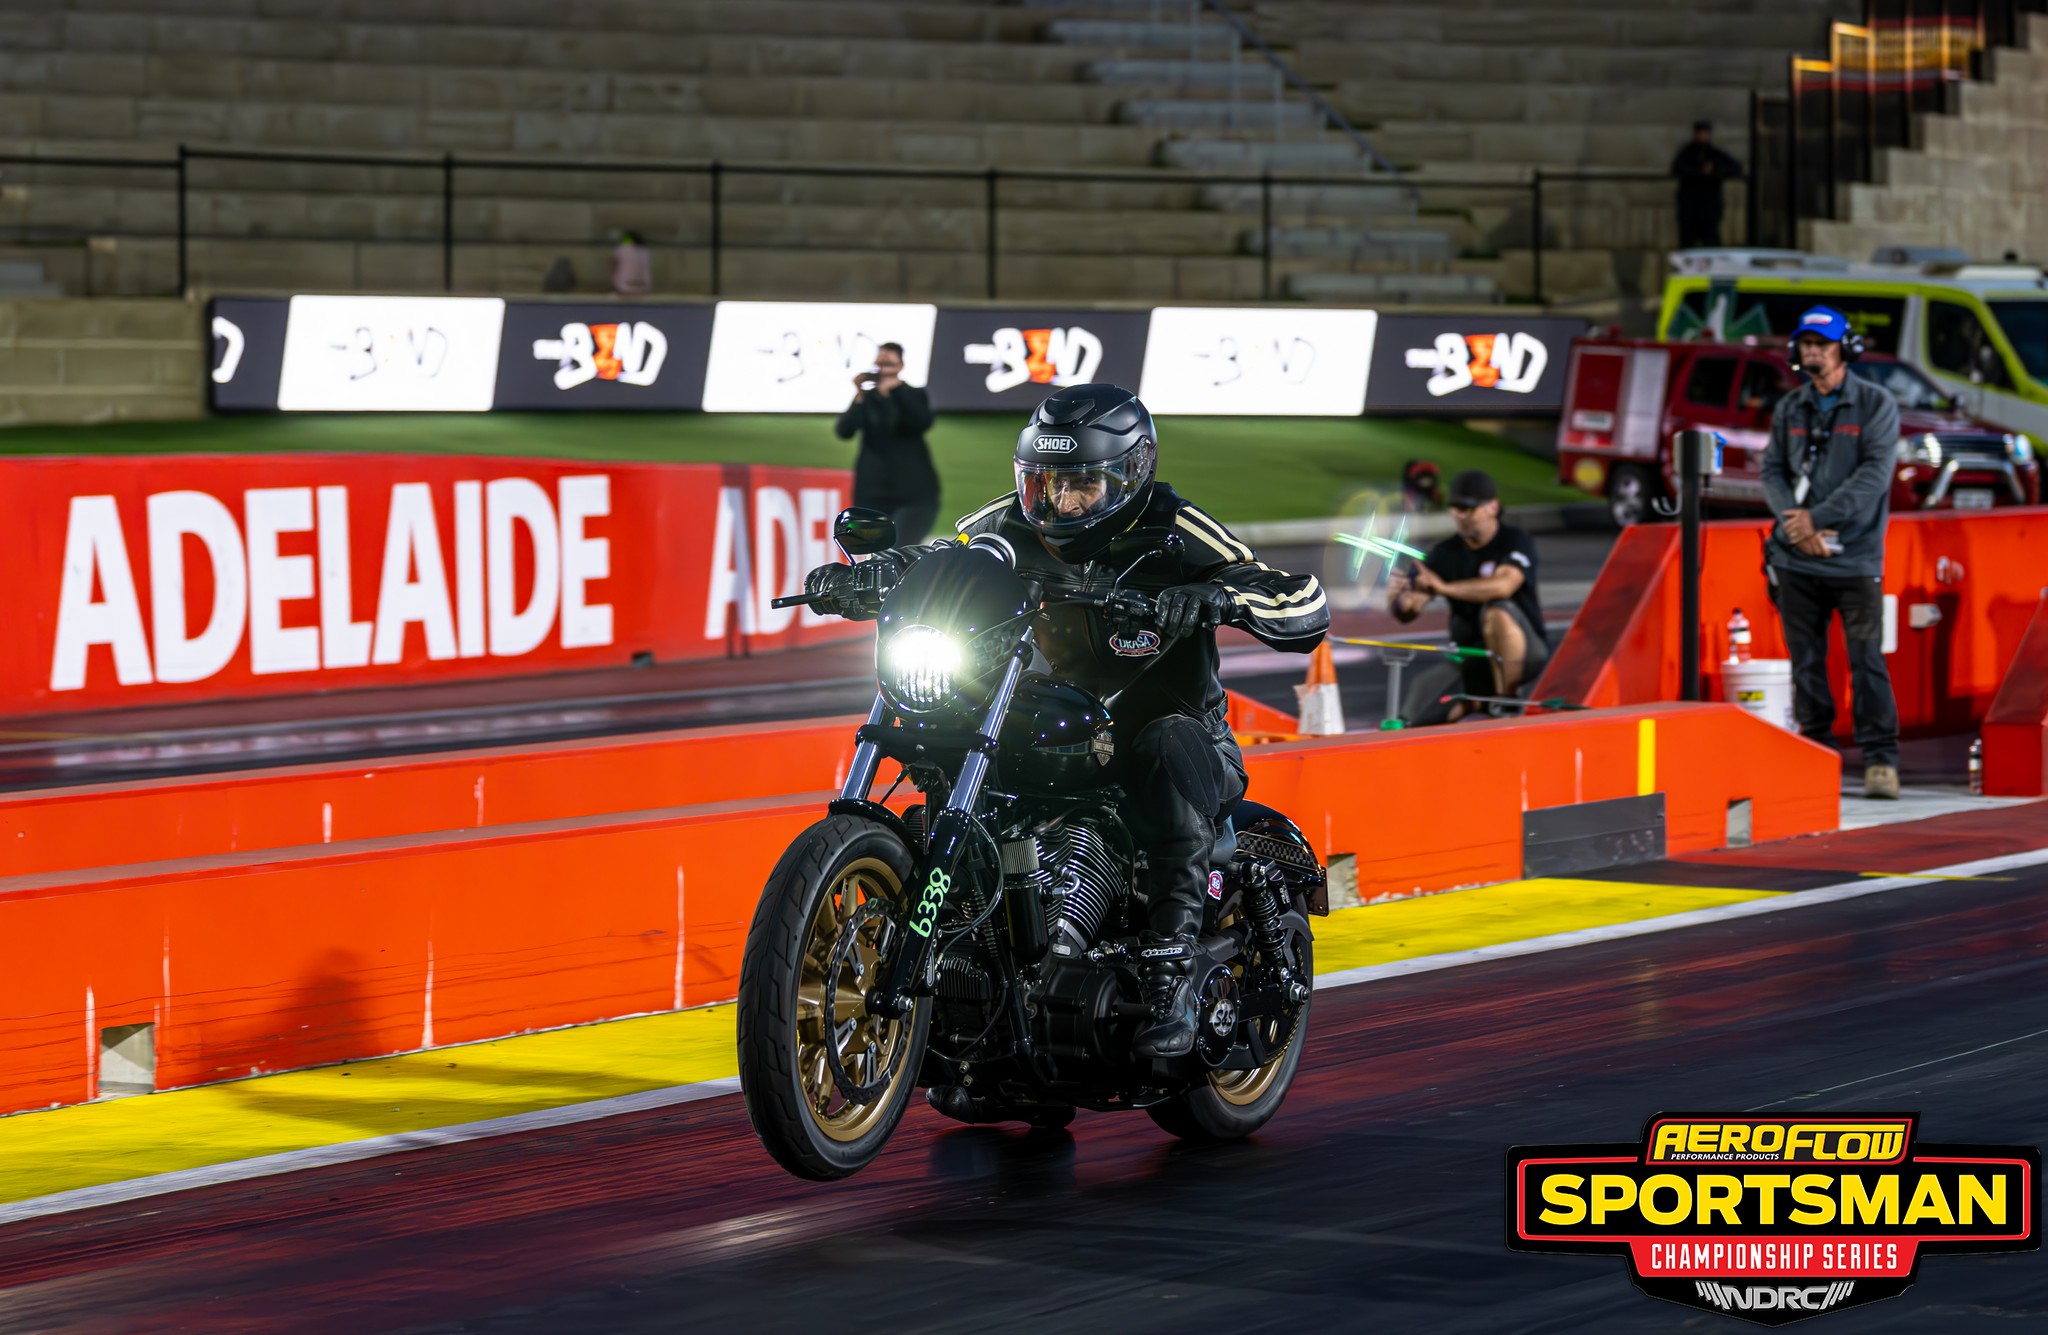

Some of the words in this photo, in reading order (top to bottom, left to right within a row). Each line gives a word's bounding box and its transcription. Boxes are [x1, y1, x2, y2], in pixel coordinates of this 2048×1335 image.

[1038, 438, 1070, 450] SHOEI
[50, 474, 615, 692] ADELAIDE
[704, 485, 848, 640] ADEL
